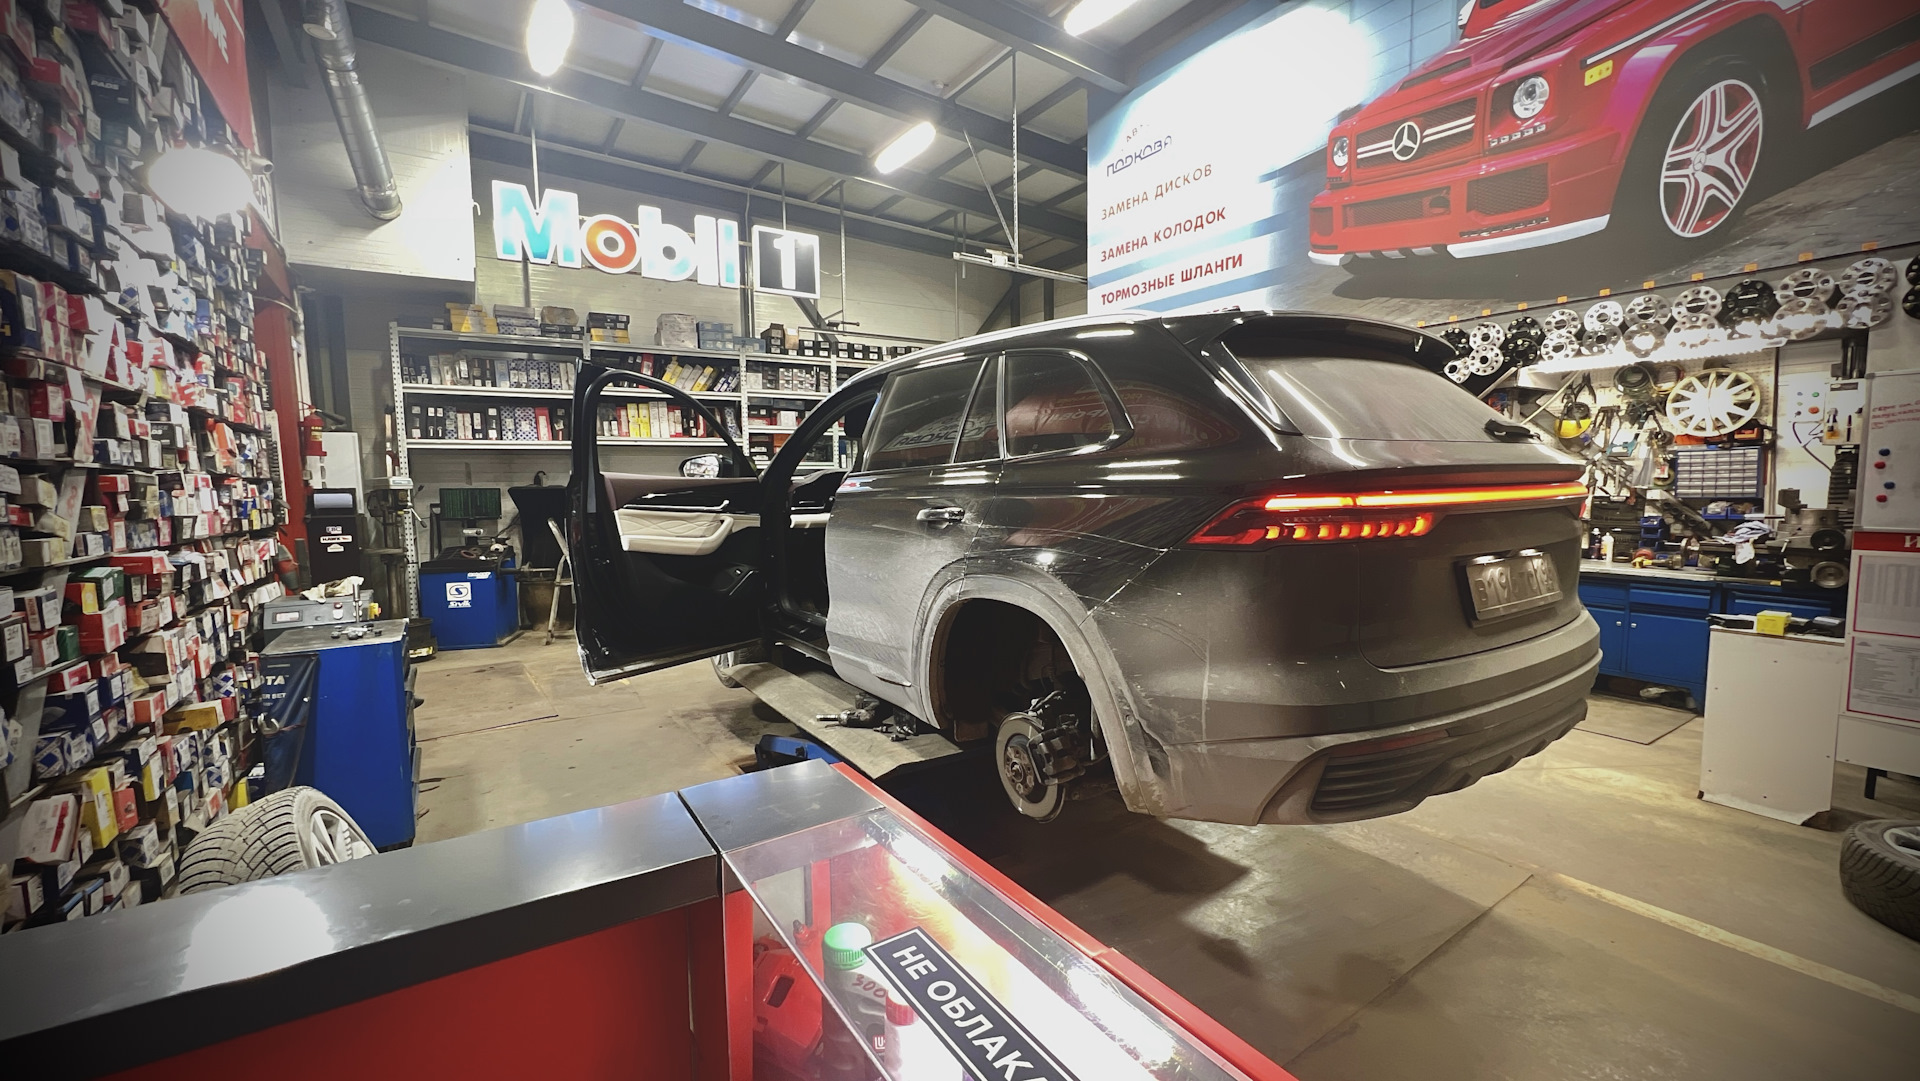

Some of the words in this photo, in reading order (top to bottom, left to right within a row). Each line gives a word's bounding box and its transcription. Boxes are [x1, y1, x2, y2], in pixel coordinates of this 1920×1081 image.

[1106, 135, 1172, 177] ПОДКОВА
[1101, 191, 1149, 221] ЗАМЕНА
[1154, 164, 1213, 200] ДИСКОВ
[491, 179, 741, 289] Mobil
[1101, 236, 1148, 262] ЗАМЕНА
[1154, 207, 1226, 243] КОЛОДОК
[1101, 273, 1175, 306] ТОРМОЗНЫЕ
[1181, 253, 1243, 283] ШЛАНГИ
[892, 945, 938, 981] НЕ
[927, 980, 1049, 1081] ОБЛАК
